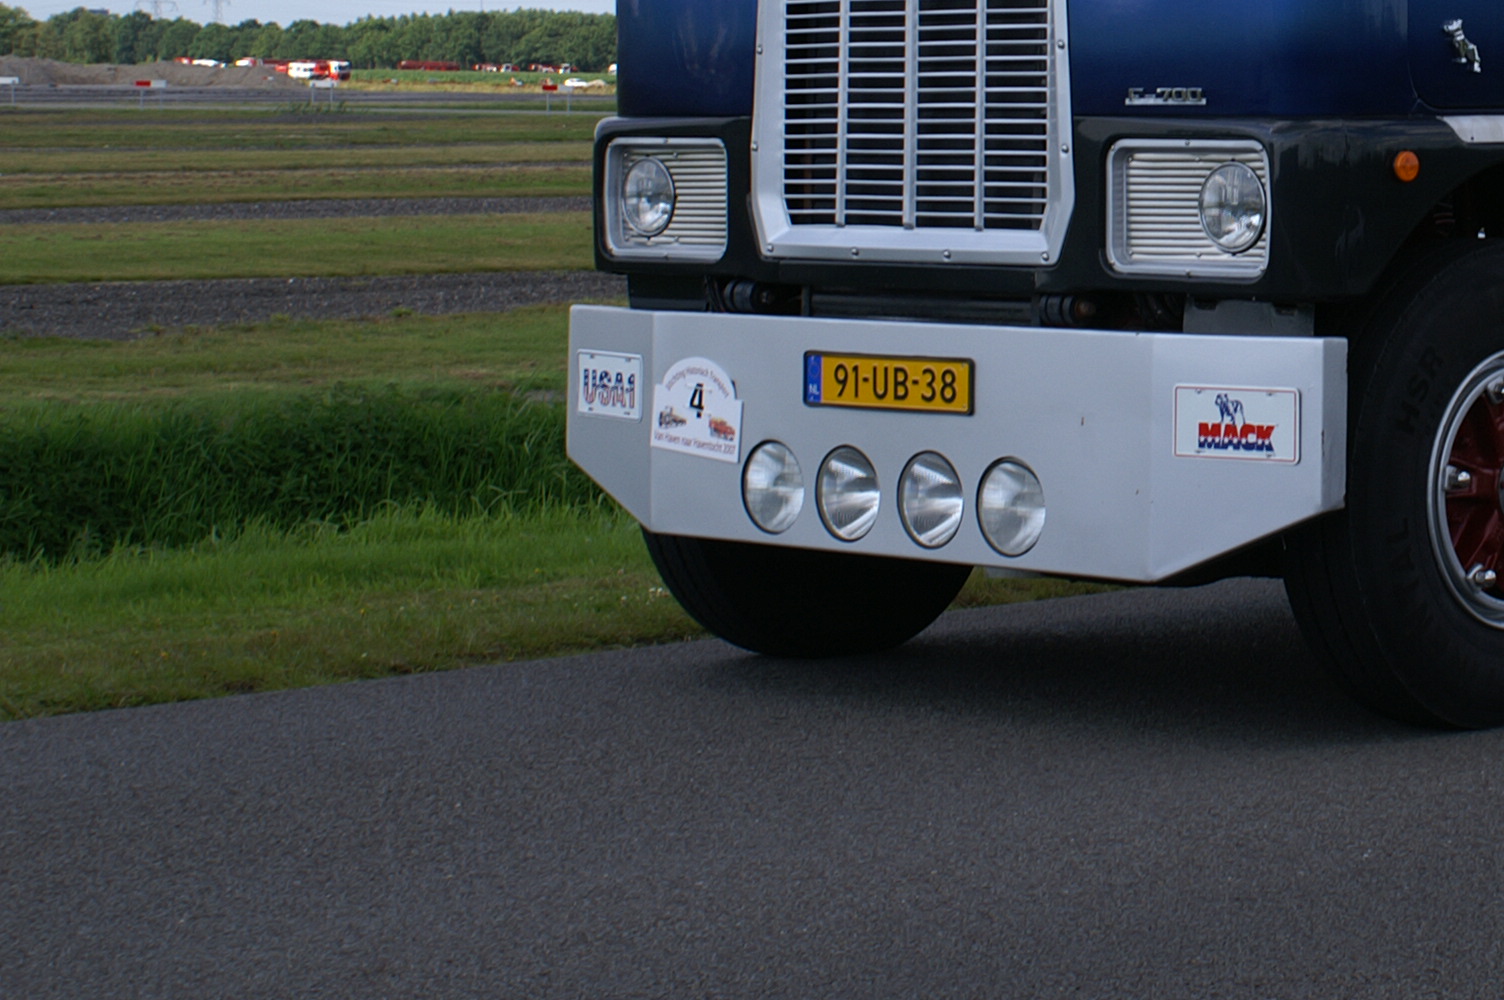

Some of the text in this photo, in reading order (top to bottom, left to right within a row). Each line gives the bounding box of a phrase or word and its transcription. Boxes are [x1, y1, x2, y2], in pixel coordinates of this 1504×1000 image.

[809, 383, 820, 395] NL
[834, 362, 957, 404] 91-UB-38
[689, 382, 705, 419] 4
[1198, 421, 1276, 452] MACK
